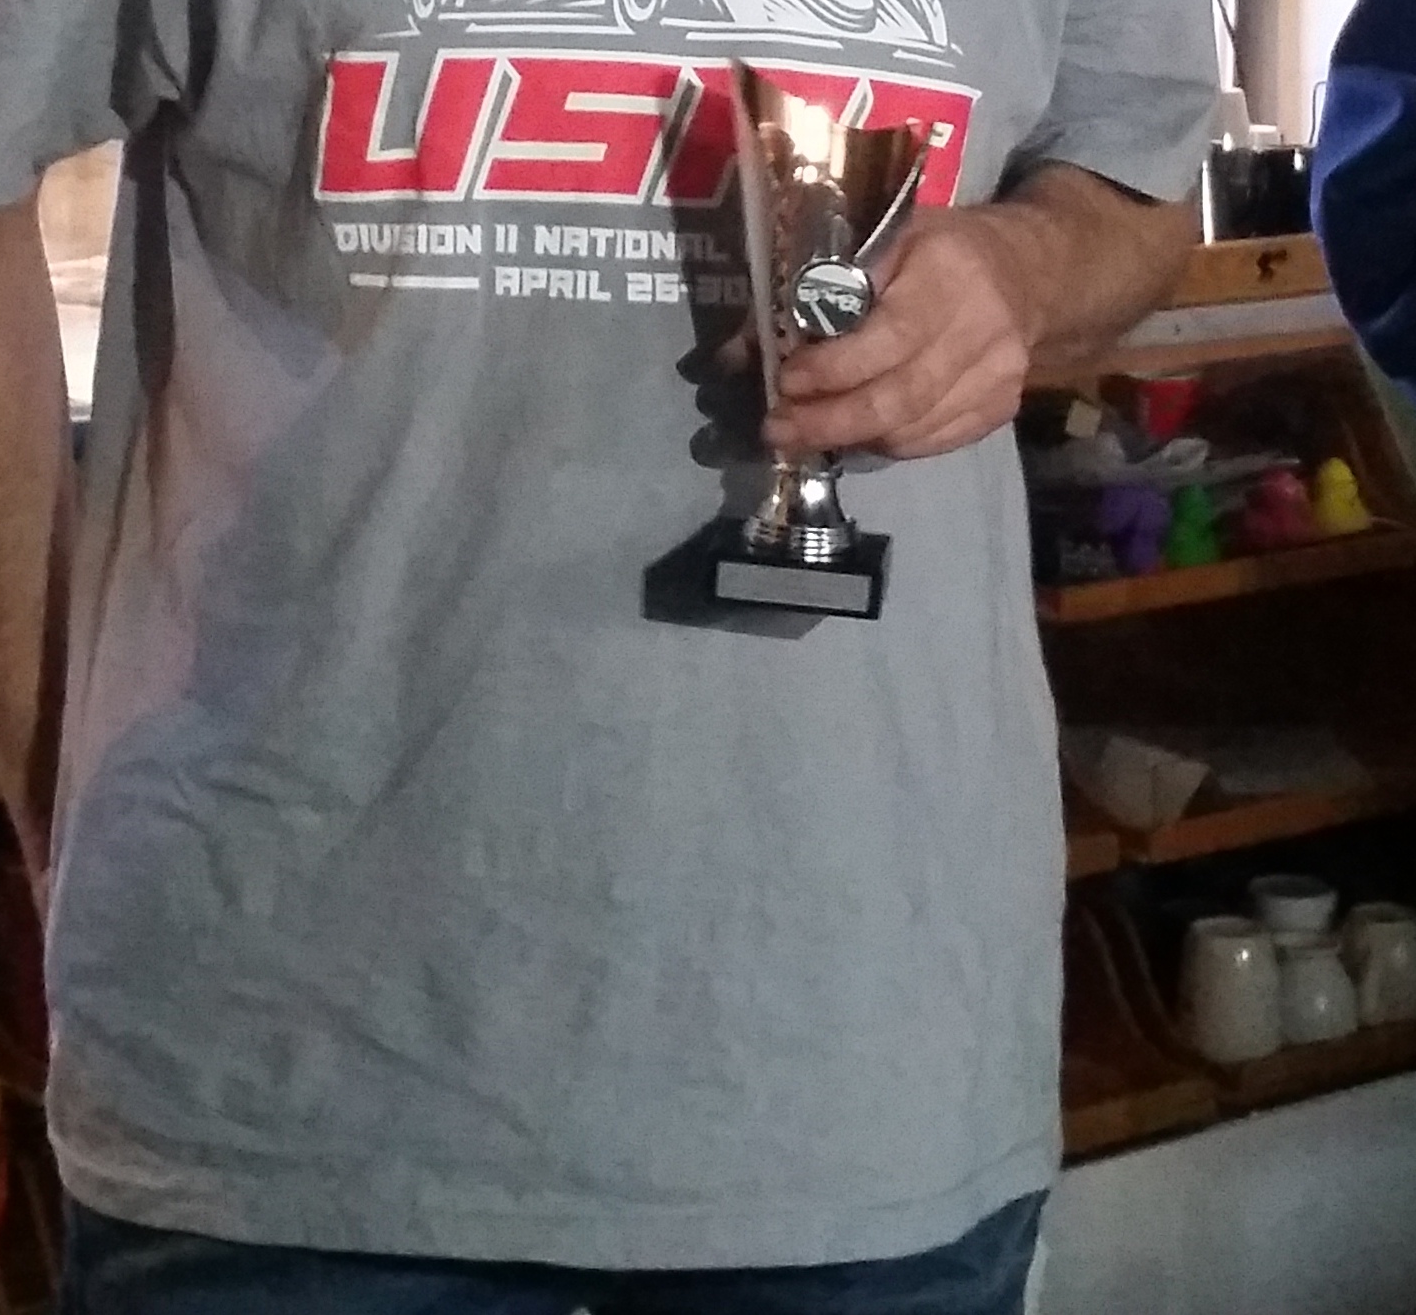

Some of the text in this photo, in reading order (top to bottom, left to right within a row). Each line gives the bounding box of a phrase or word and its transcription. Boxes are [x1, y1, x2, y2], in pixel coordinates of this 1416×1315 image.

[333, 222, 483, 255] DIVISION
[494, 223, 518, 254] II
[494, 265, 612, 303] APRIL
